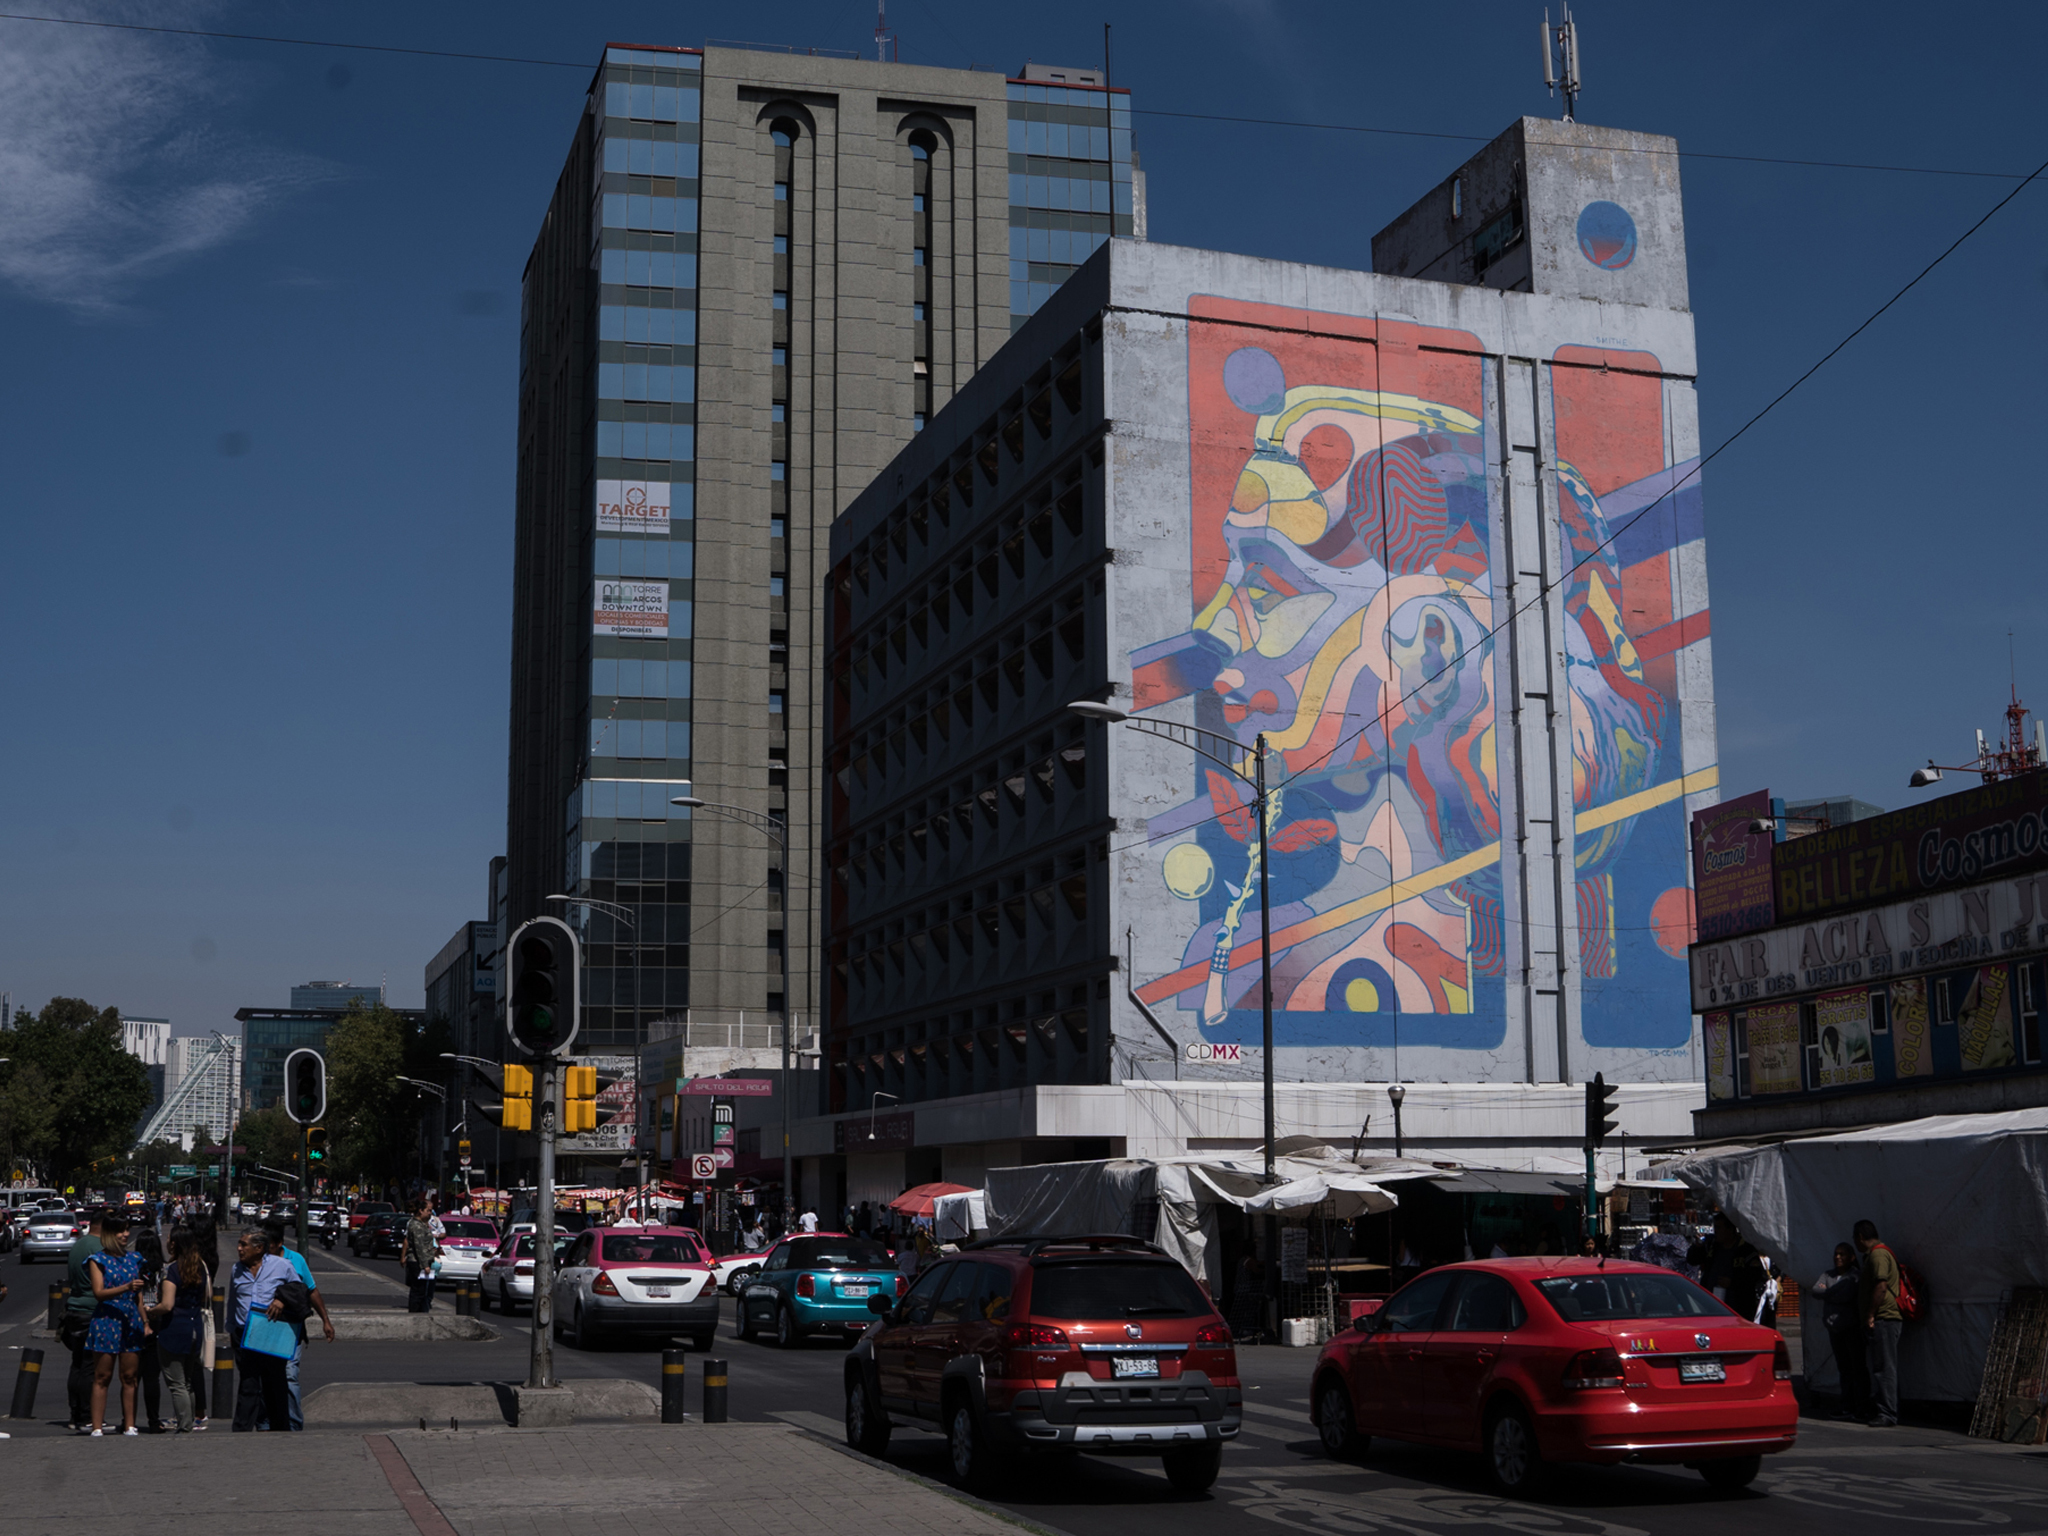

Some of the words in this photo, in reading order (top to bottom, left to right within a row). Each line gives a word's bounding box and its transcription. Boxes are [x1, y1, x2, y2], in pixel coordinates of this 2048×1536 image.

[599, 502, 671, 517] TARGET
[632, 585, 662, 593] TORRE
[602, 604, 663, 612] DOWNTOWN
[1775, 827, 1859, 867] ACADEMIA
[1870, 780, 2025, 841] ESPECIALIZADA
[1916, 804, 2048, 889] Cosmos
[1704, 844, 1748, 875] Cosmos
[1757, 863, 1771, 874] SEP
[1780, 840, 1911, 918] BELLEZA
[1741, 894, 1770, 907] BELLEZA
[1738, 979, 1759, 999] DE
[1868, 954, 1892, 976] EN
[2000, 925, 2030, 950] DE
[1815, 991, 1868, 1011] CORTES
[1749, 1004, 1798, 1019] BECAS
[1818, 1006, 1867, 1026] GRATIS
[1963, 966, 2009, 1066] MAQUILLAJE
[1710, 1014, 1730, 1077] MASAJES
[1899, 1006, 1929, 1076] COLOR
[1186, 1044, 1240, 1059] CDMX
[1819, 1071, 1831, 1085] 55
[1833, 1069, 1846, 1083] 10
[1847, 1067, 1860, 1081] 34
[1860, 1064, 1873, 1080] 66
[695, 1083, 724, 1091] SALTO
